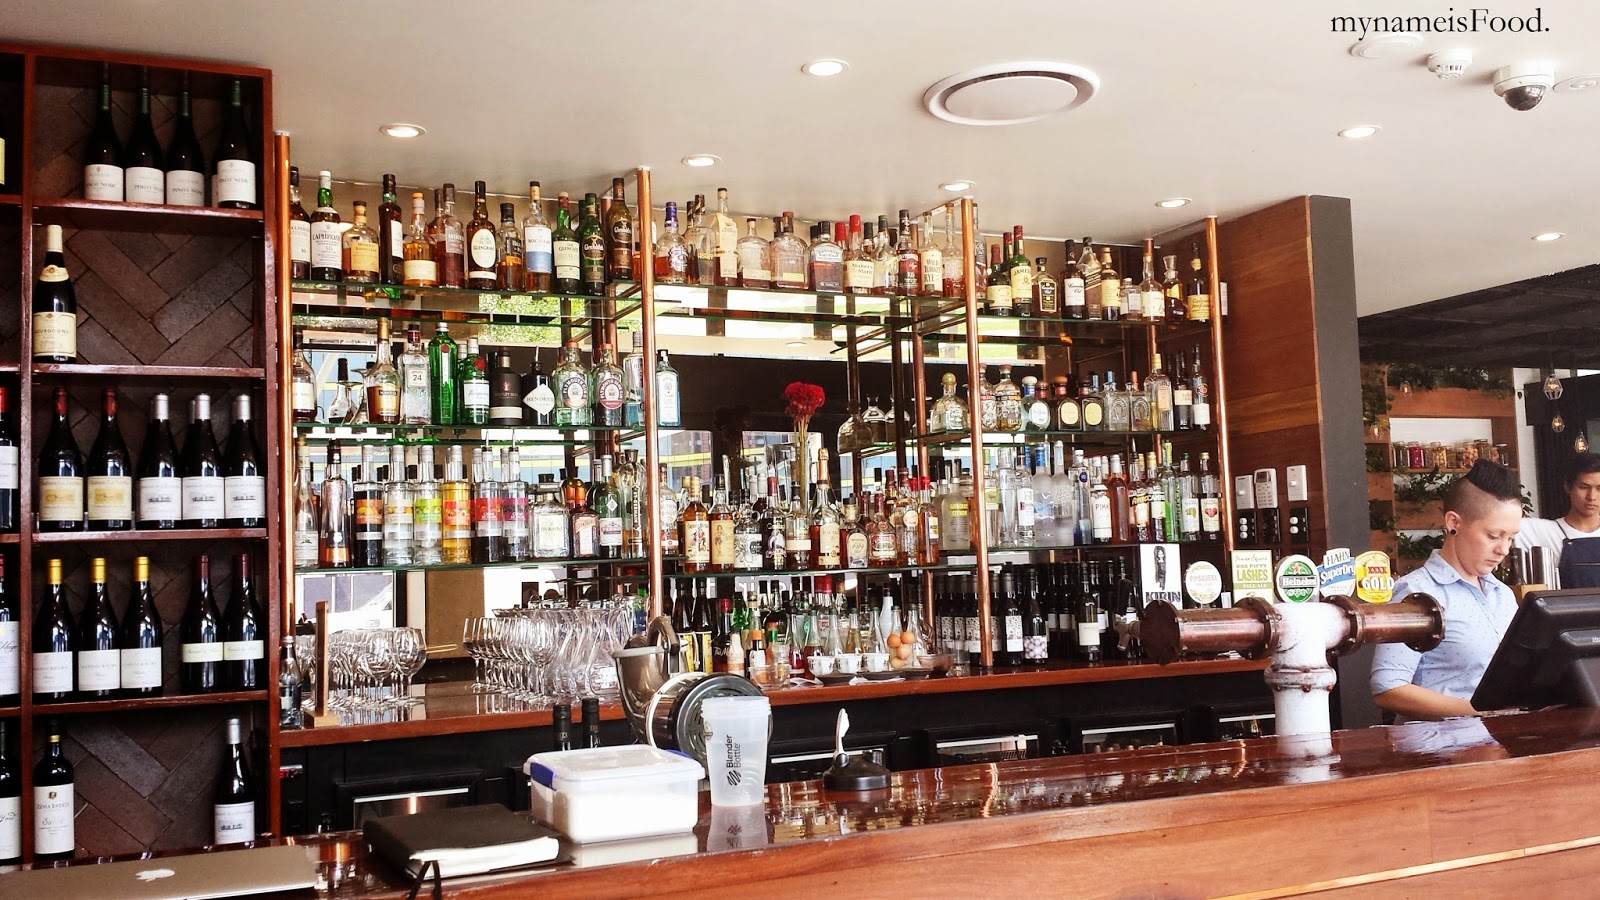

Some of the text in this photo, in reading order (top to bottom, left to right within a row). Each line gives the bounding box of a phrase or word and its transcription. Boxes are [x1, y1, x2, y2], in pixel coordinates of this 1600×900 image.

[923, 274, 935, 282] RYE
[1326, 551, 1351, 566] HAHN
[1236, 569, 1268, 582] LASHES
[1320, 563, 1356, 585] SuperDry
[1367, 566, 1388, 575] XXXX
[1282, 577, 1317, 587] Heineken
[1361, 576, 1396, 591] GOLD
[1145, 591, 1181, 603] KIRIN
[726, 734, 734, 769] Blender
[733, 742, 742, 769] Bottle
